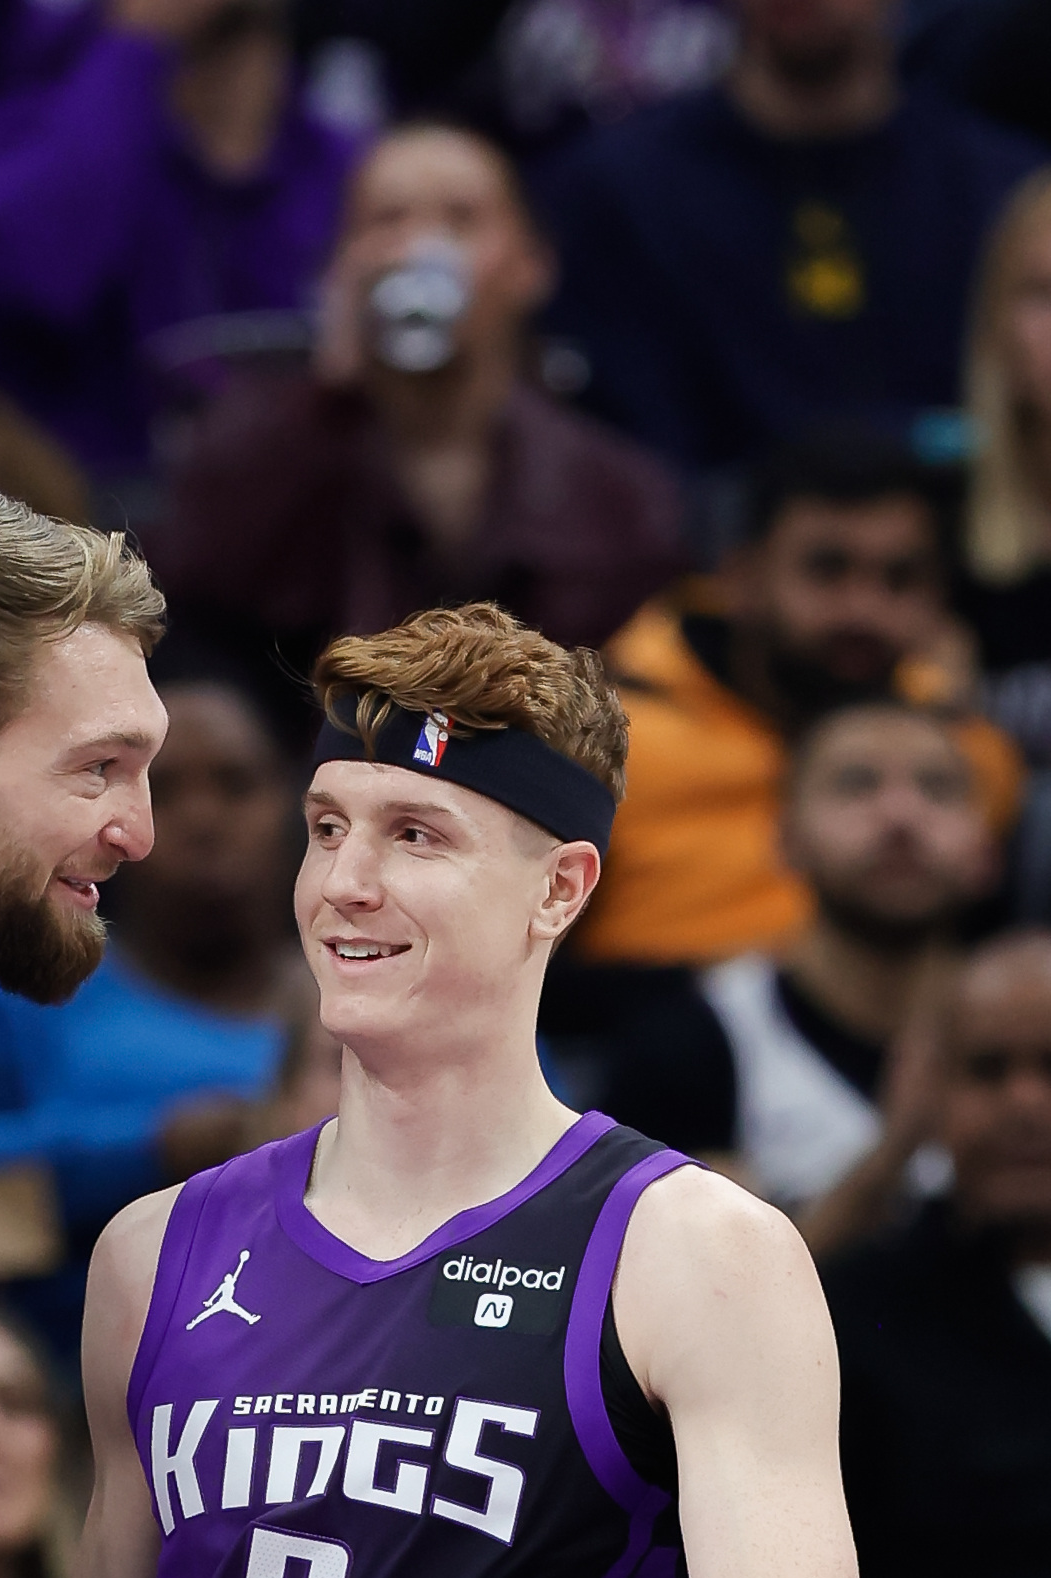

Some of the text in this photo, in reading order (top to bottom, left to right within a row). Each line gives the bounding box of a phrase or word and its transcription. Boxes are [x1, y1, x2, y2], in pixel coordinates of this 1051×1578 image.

[442, 1254, 566, 1291] dialpad
[232, 1388, 445, 1416] SACRAMENTO
[150, 1398, 540, 1547] KINGS
